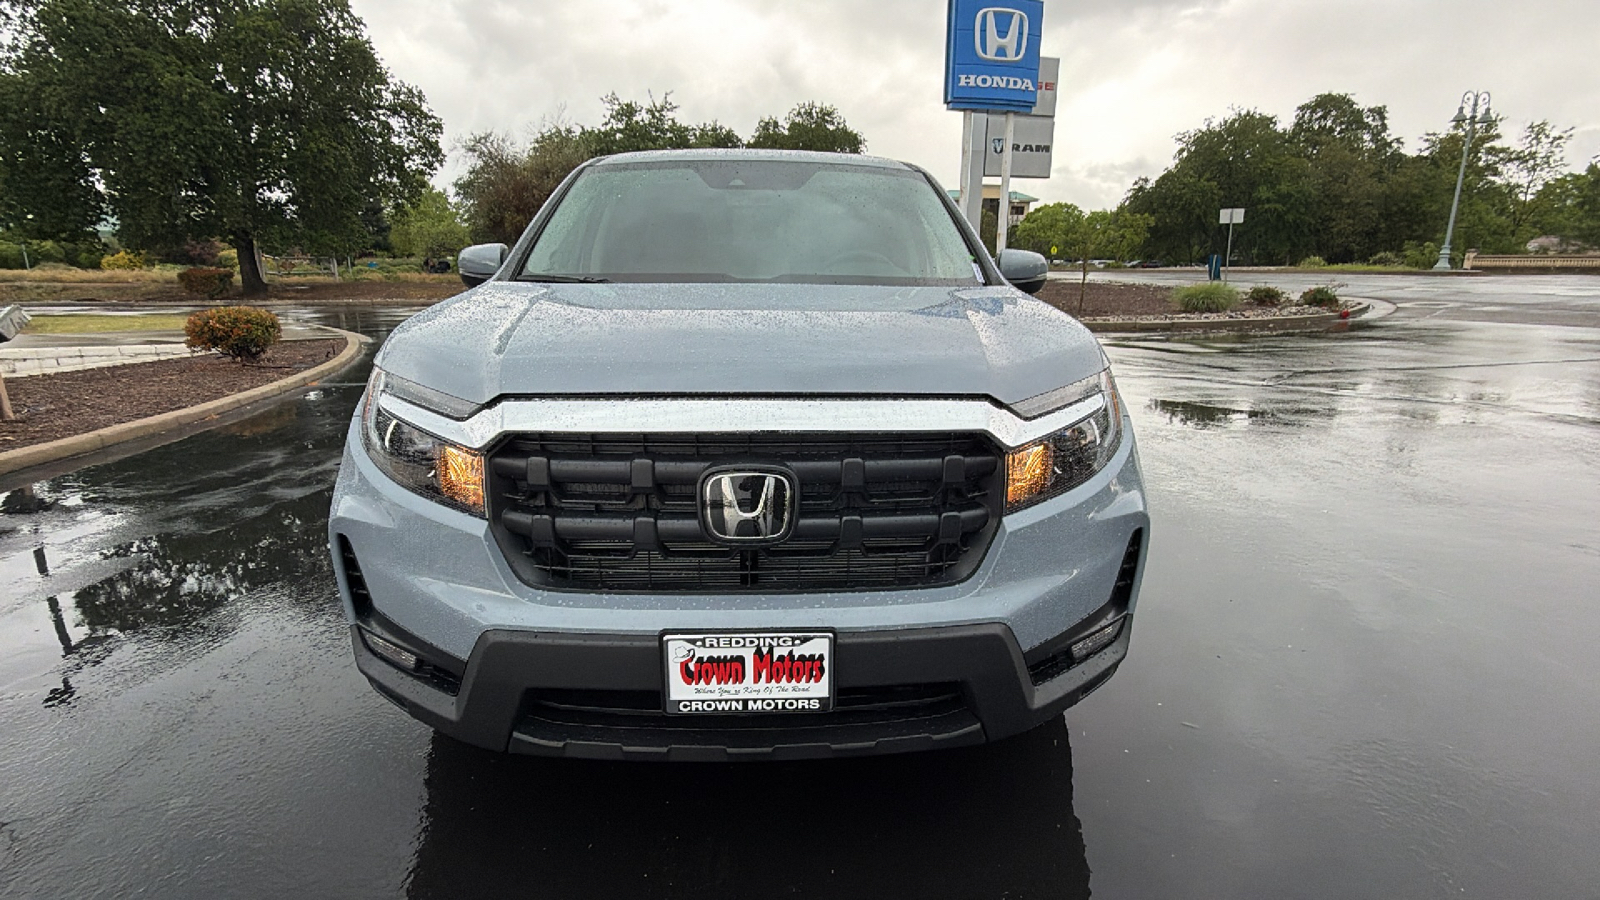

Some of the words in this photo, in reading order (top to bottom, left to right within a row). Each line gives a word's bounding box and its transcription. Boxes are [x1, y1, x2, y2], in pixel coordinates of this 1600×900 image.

[958, 74, 1035, 92] HONDA
[1012, 143, 1050, 153] RAM
[705, 637, 792, 647] REDDING
[680, 655, 745, 685] Crown
[753, 650, 824, 684] Motors
[743, 686, 761, 694] King
[763, 686, 774, 694] Of
[776, 685, 789, 693] The
[679, 701, 743, 712] CROWN
[748, 699, 820, 710] MOTORS
